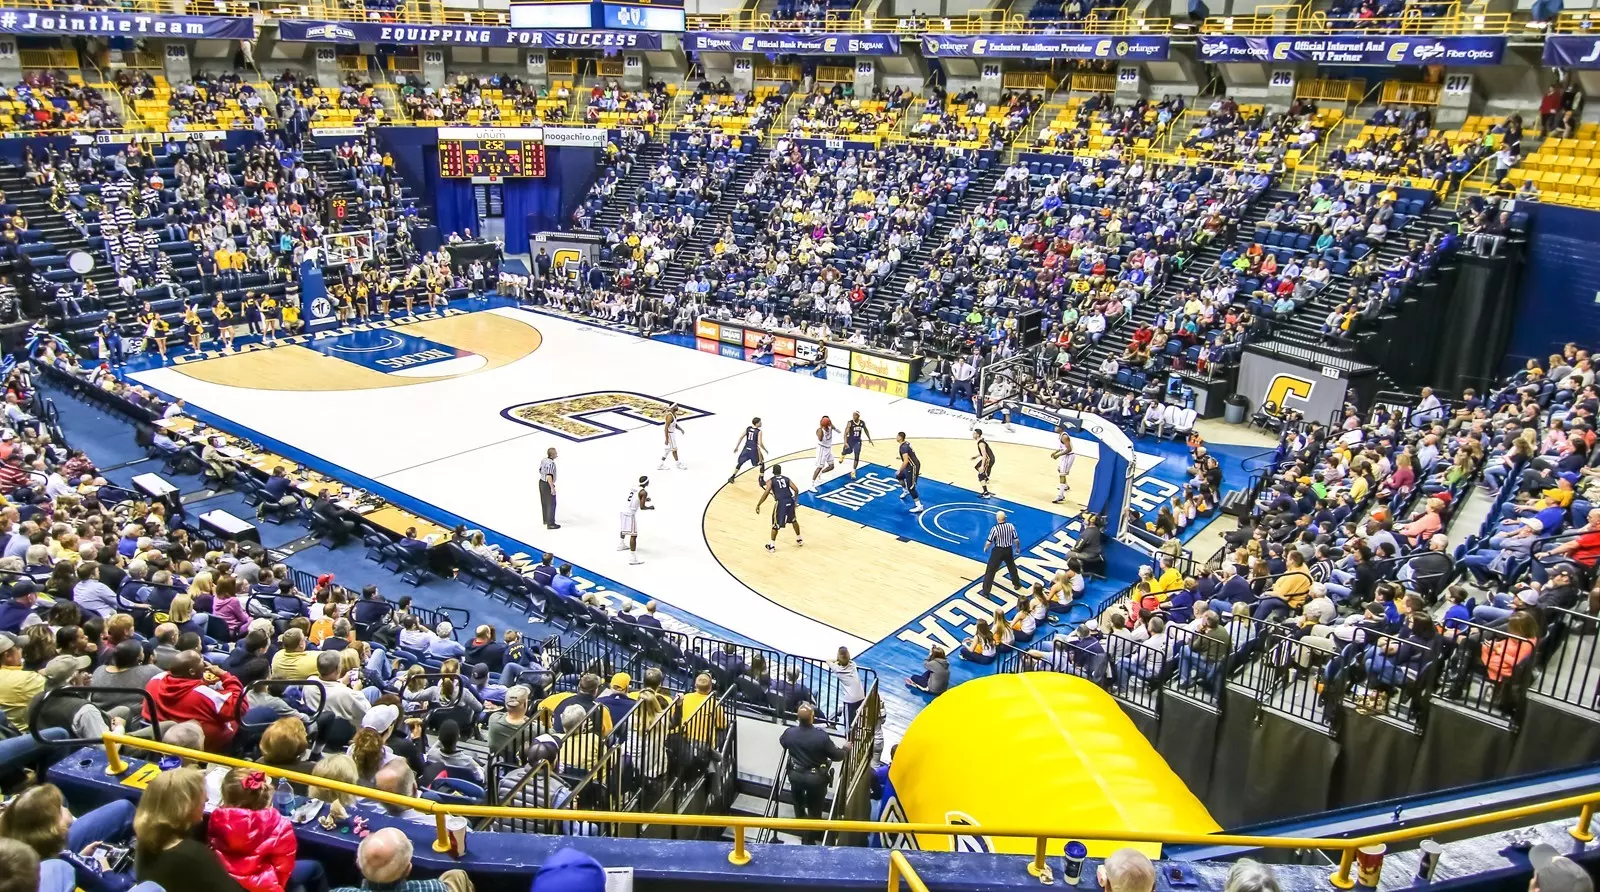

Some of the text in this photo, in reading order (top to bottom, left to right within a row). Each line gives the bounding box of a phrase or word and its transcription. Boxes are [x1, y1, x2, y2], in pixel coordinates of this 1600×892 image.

[1, 12, 204, 34] #JointheTeam
[381, 27, 637, 46] EQUIPPING FOR SUCCESS
[757, 40, 779, 48] Official
[797, 41, 821, 49] Partner
[939, 43, 968, 54] erlanger
[989, 43, 1020, 52] Exclusive
[1022, 43, 1059, 52] Healthcare
[1061, 43, 1092, 53] Provider
[1129, 44, 1160, 55] erlanger
[1294, 41, 1384, 51] Official Internet And
[317, 49, 334, 59] 209
[426, 51, 441, 62] 210
[1230, 47, 1247, 55] Fiber
[1247, 47, 1269, 57] Optics
[1312, 52, 1363, 61] TV Partner
[1446, 50, 1466, 58] Fiber
[1468, 50, 1493, 59] Optics
[529, 54, 544, 64] 210
[627, 57, 639, 66] 211
[736, 59, 750, 69] 212
[858, 62, 871, 72] 213
[984, 65, 998, 76] 214
[1121, 69, 1136, 80] 215
[1273, 72, 1290, 84] 216
[1447, 77, 1469, 90] 217
[545, 132, 606, 142] noogachiro.net
[485, 140, 504, 150] 2:52
[829, 140, 840, 148] 114
[468, 154, 480, 164] 20
[508, 154, 520, 164] 29
[376, 348, 455, 369] SOCON
[1324, 368, 1338, 379] 117
[776, 478, 787, 489] 13
[627, 491, 634, 502] 2
